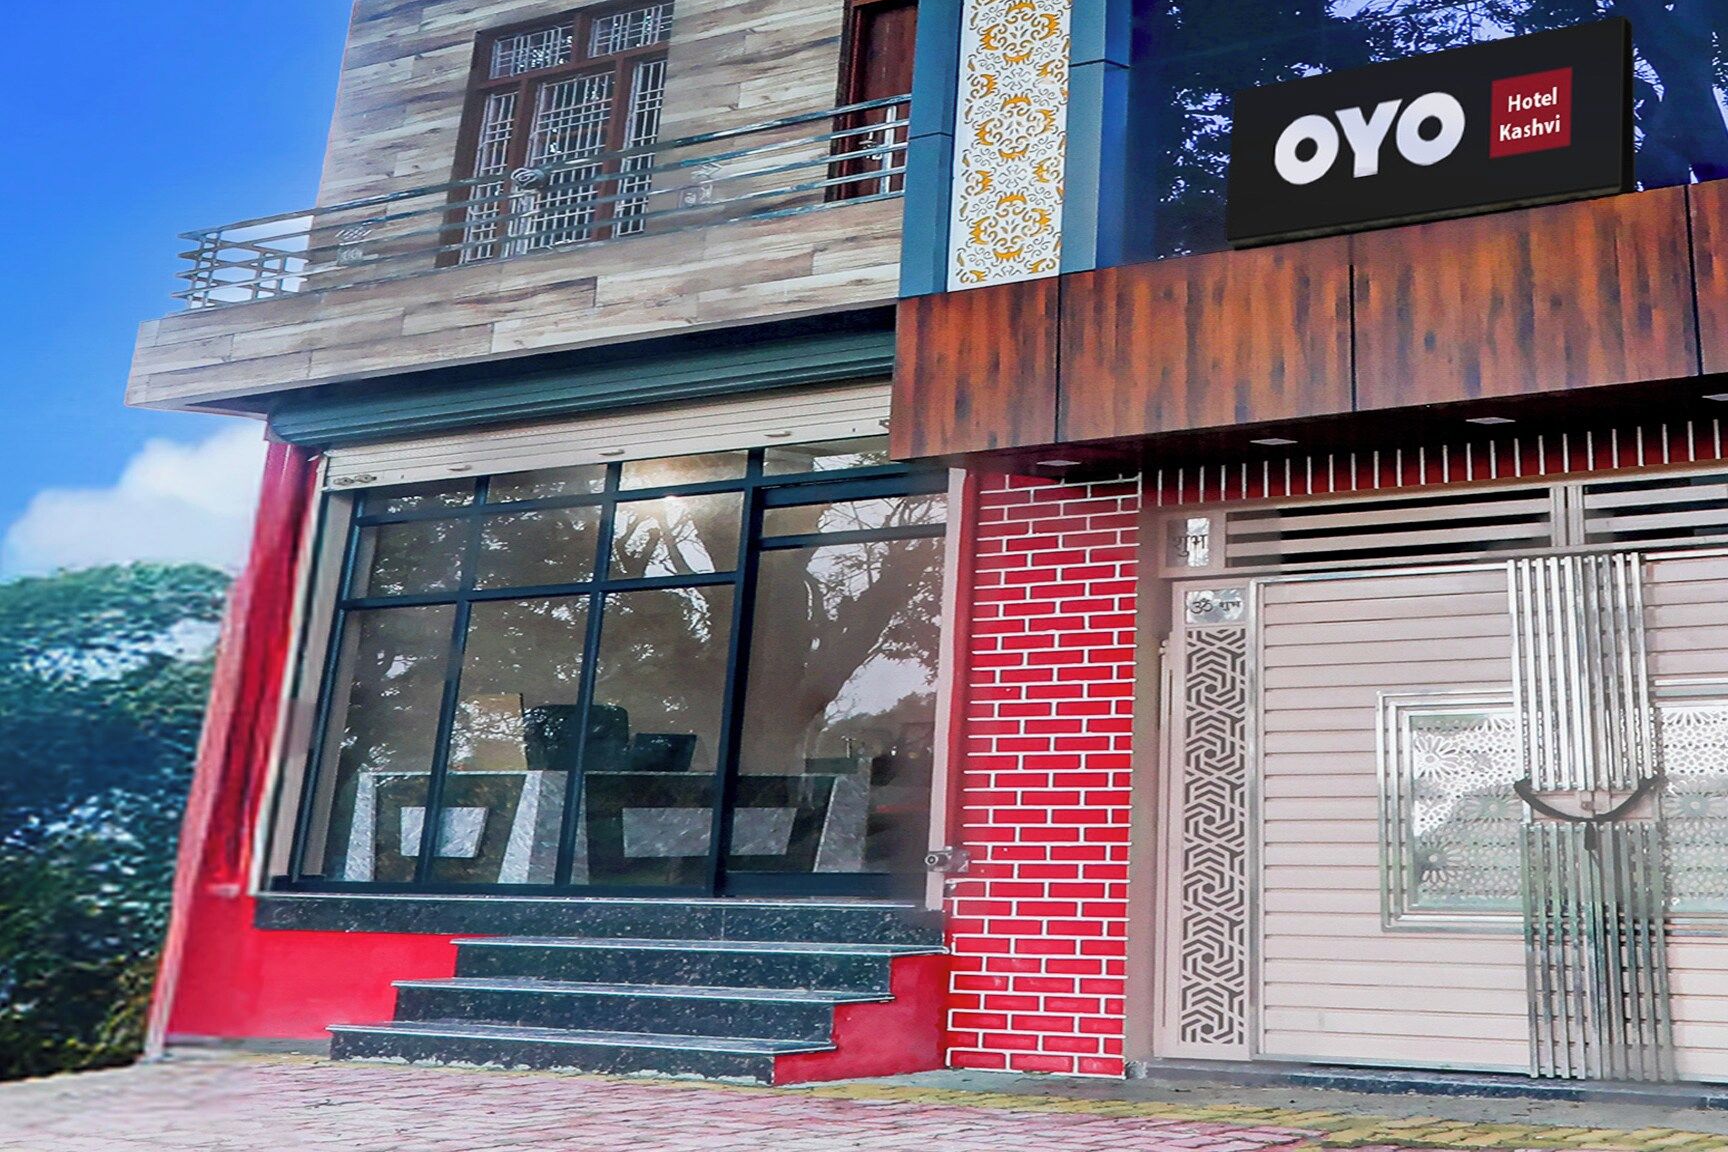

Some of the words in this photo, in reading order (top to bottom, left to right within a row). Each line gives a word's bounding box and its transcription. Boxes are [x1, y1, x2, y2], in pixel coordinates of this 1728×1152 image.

[1508, 86, 1558, 113] Hotel
[1274, 92, 1466, 185] OYO
[1499, 114, 1561, 142] Kashvi
